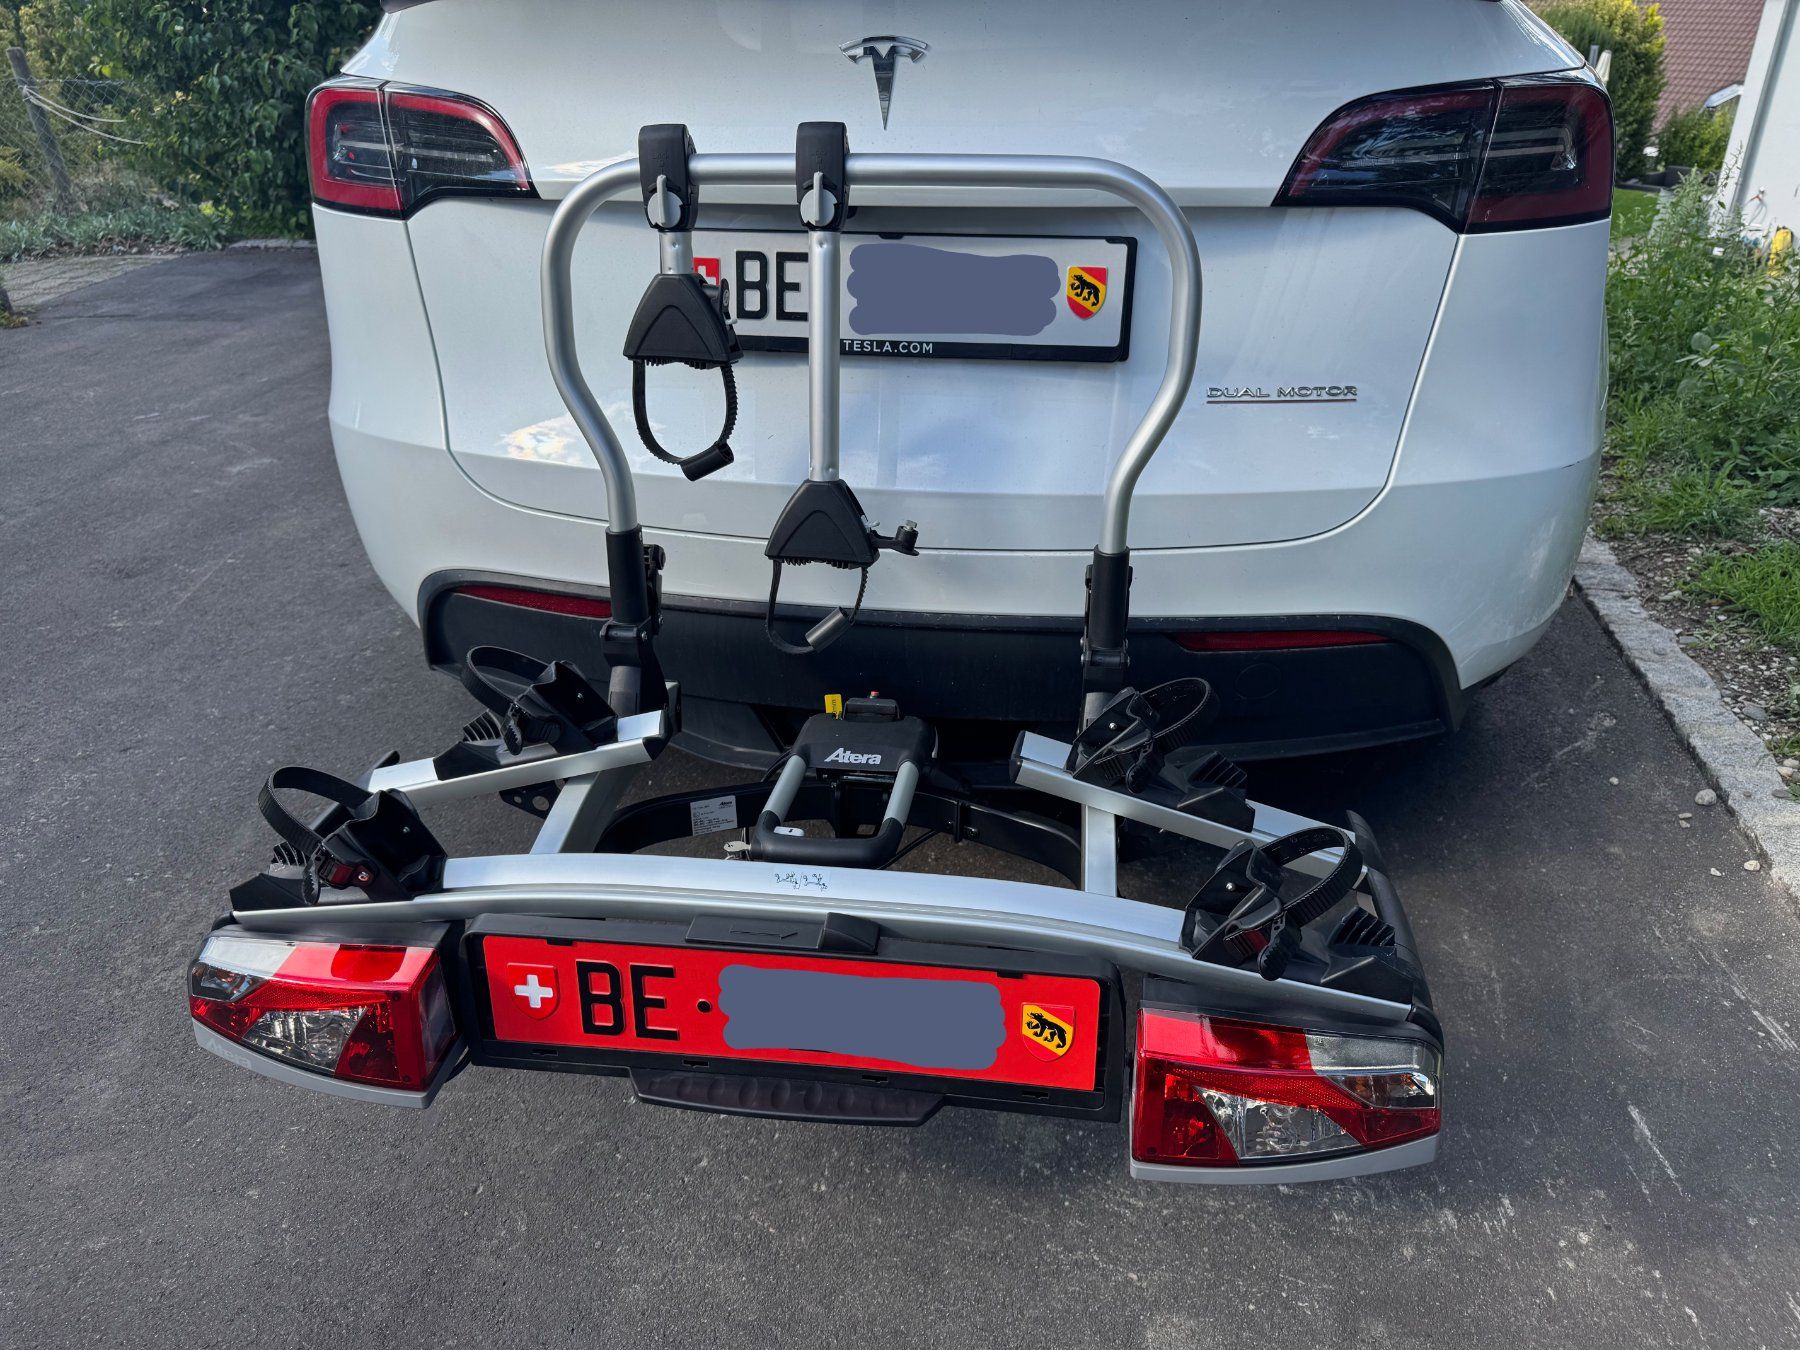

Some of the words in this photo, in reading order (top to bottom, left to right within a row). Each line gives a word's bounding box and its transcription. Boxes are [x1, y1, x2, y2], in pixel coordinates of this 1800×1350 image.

[736, 250, 809, 322] BE
[843, 339, 934, 354] TESLA.COM
[1206, 386, 1270, 398] DUAL
[1277, 385, 1358, 398] MOTOR
[824, 747, 882, 765] Atera
[575, 958, 681, 1042] BE
